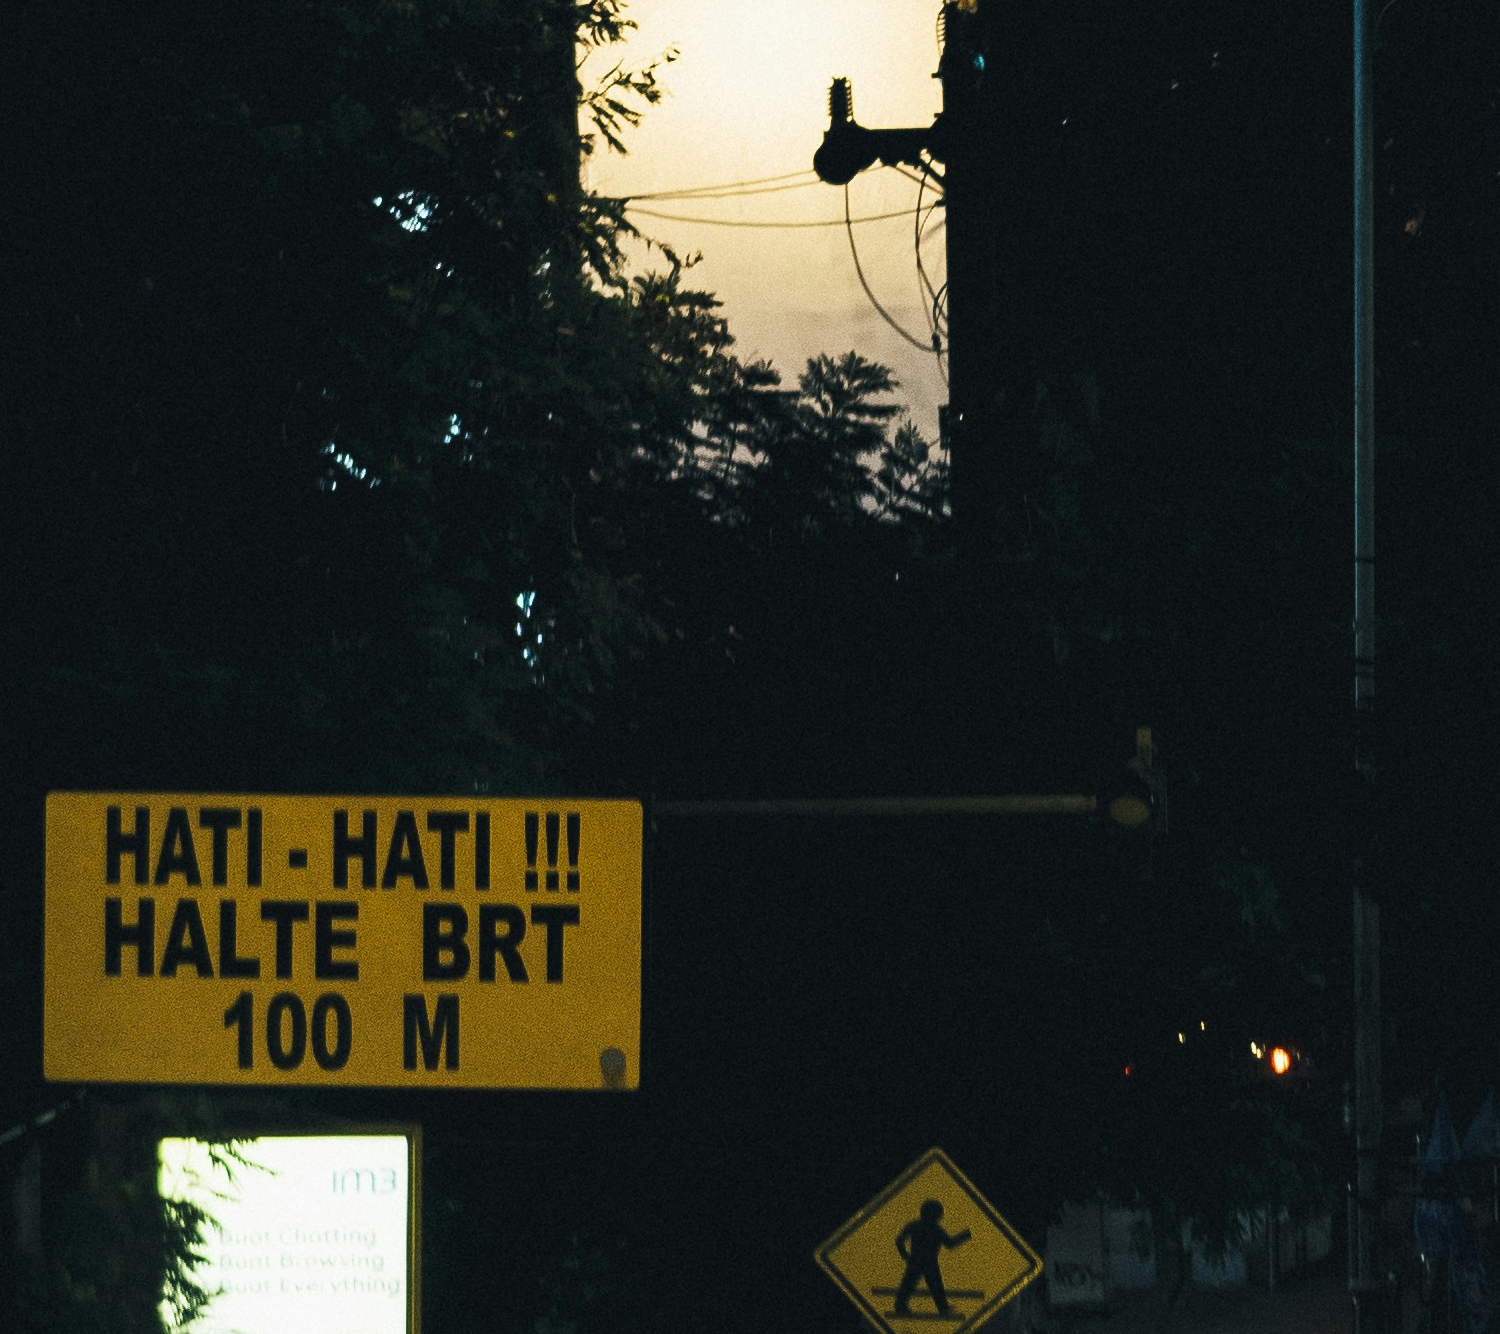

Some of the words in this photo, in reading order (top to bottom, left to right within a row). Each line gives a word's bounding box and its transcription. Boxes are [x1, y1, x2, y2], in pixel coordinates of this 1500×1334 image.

[103, 806, 264, 889] HATI
[333, 810, 491, 892] HATI
[524, 812, 583, 894] !!!
[103, 897, 361, 981] HALTE
[420, 903, 581, 984] BRT
[222, 990, 353, 1072] 100
[402, 993, 462, 1072] M
[279, 1227, 379, 1250] Chatting
[279, 1254, 387, 1274] Browsing
[279, 1278, 402, 1300] Everything
